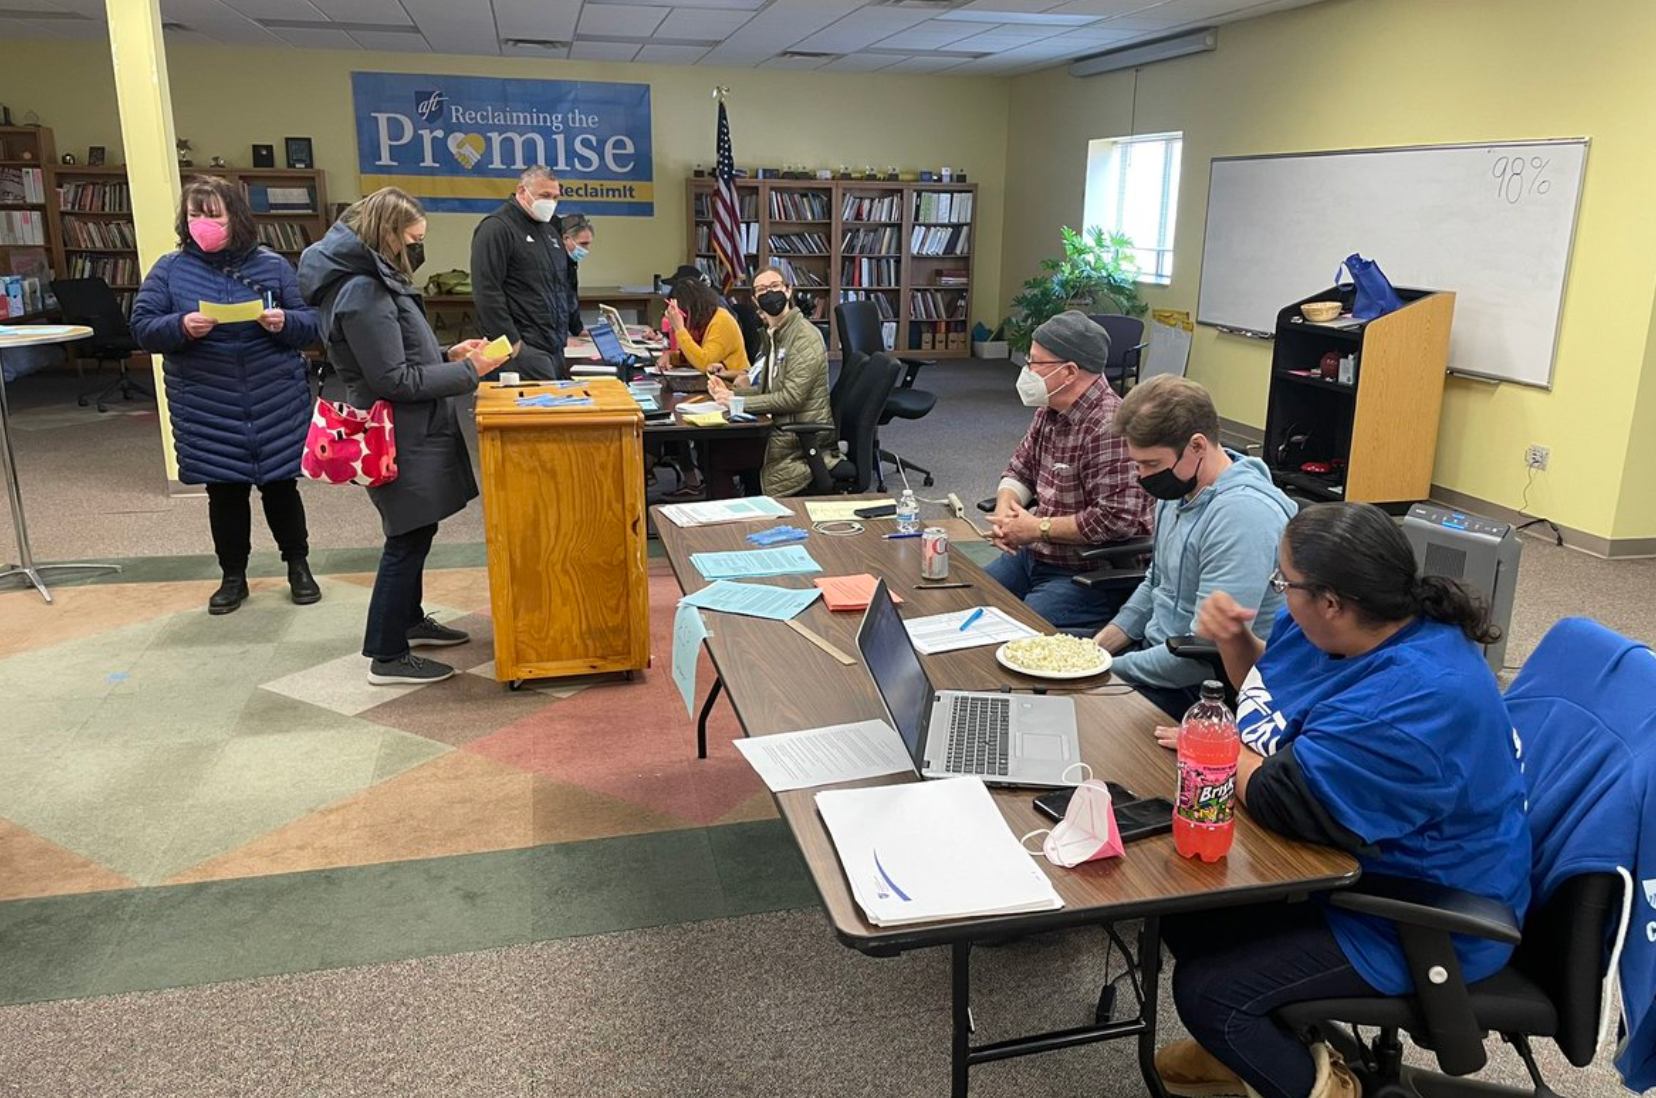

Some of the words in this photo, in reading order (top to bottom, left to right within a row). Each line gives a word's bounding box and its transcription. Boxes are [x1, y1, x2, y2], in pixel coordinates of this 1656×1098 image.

[417, 91, 449, 120] aft
[450, 105, 564, 130] Reclaiming
[568, 109, 599, 128] the
[1492, 156, 1551, 204] 98%
